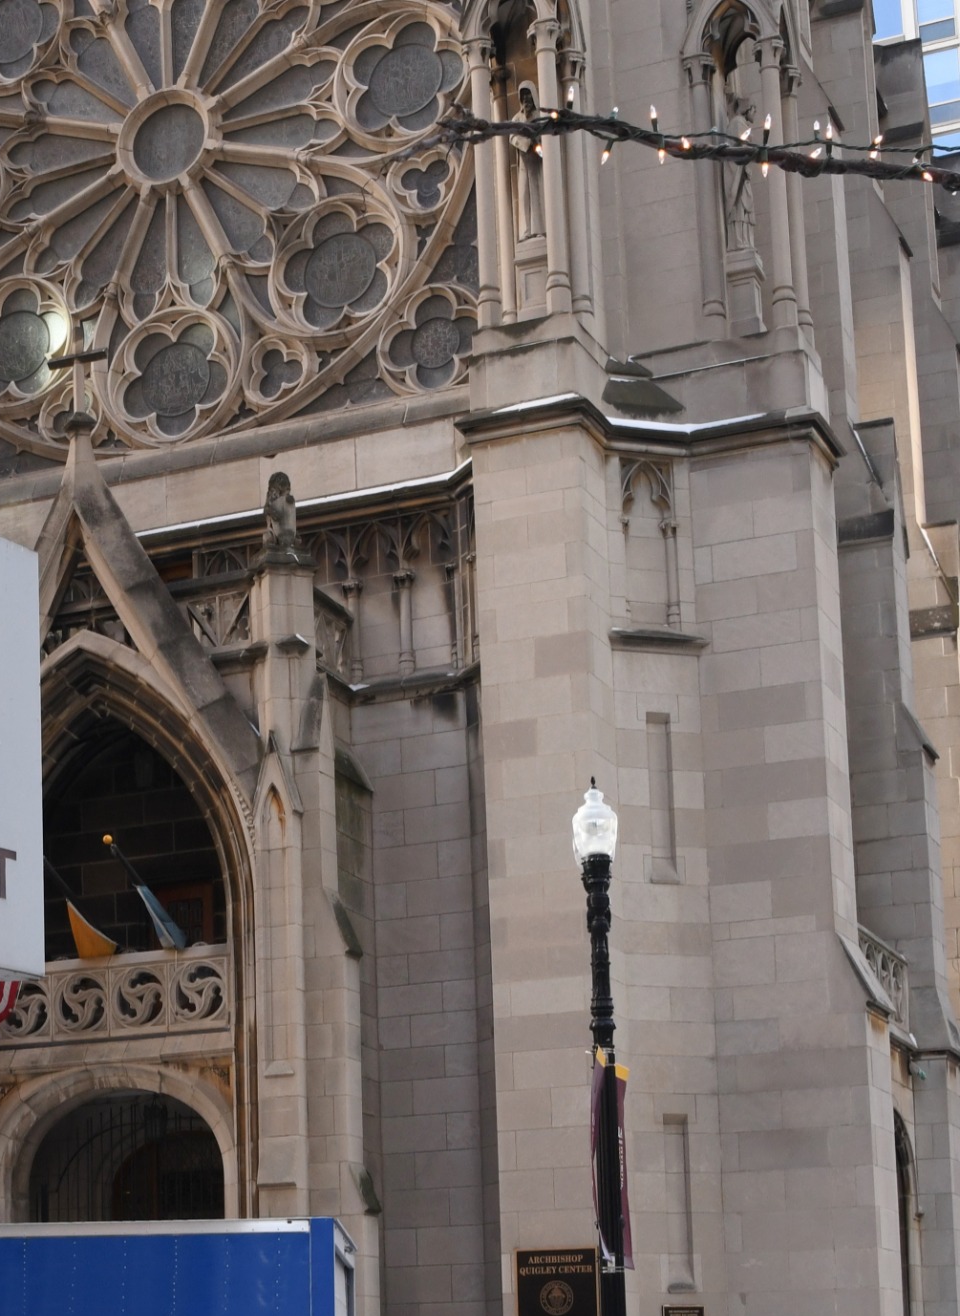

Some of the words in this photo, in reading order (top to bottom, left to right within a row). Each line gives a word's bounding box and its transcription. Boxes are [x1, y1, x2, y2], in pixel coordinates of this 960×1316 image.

[528, 1254, 583, 1264] ARCHBISHOP
[520, 1266, 557, 1276] QUIGLEY
[558, 1265, 593, 1273] CENTER
